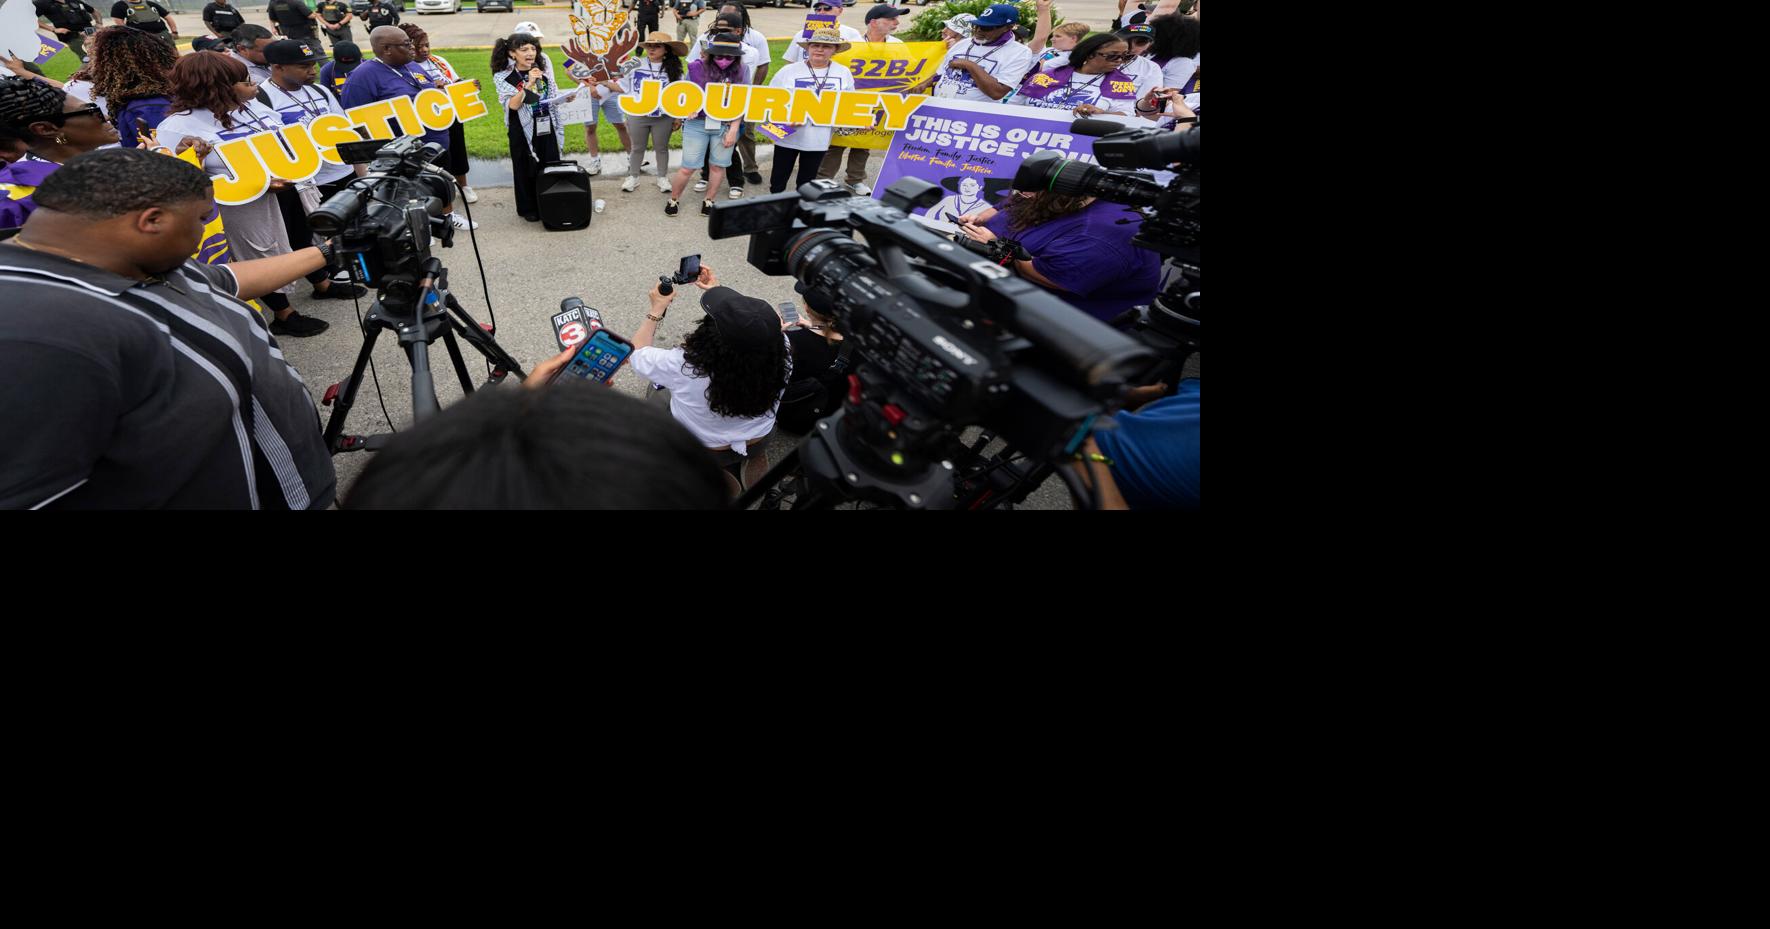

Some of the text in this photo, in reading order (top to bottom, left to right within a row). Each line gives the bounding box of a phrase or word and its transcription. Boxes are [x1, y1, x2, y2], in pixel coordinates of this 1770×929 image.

[850, 58, 928, 77] 32BJ
[618, 79, 928, 131] JOURNEY
[211, 79, 488, 206] JUSTICE
[905, 129, 1019, 158] JUSTICE
[911, 115, 968, 135] THIS
[971, 124, 1001, 140] IS
[1006, 128, 1074, 150] OUR
[556, 310, 579, 325] KATC
[561, 321, 587, 347] 3
